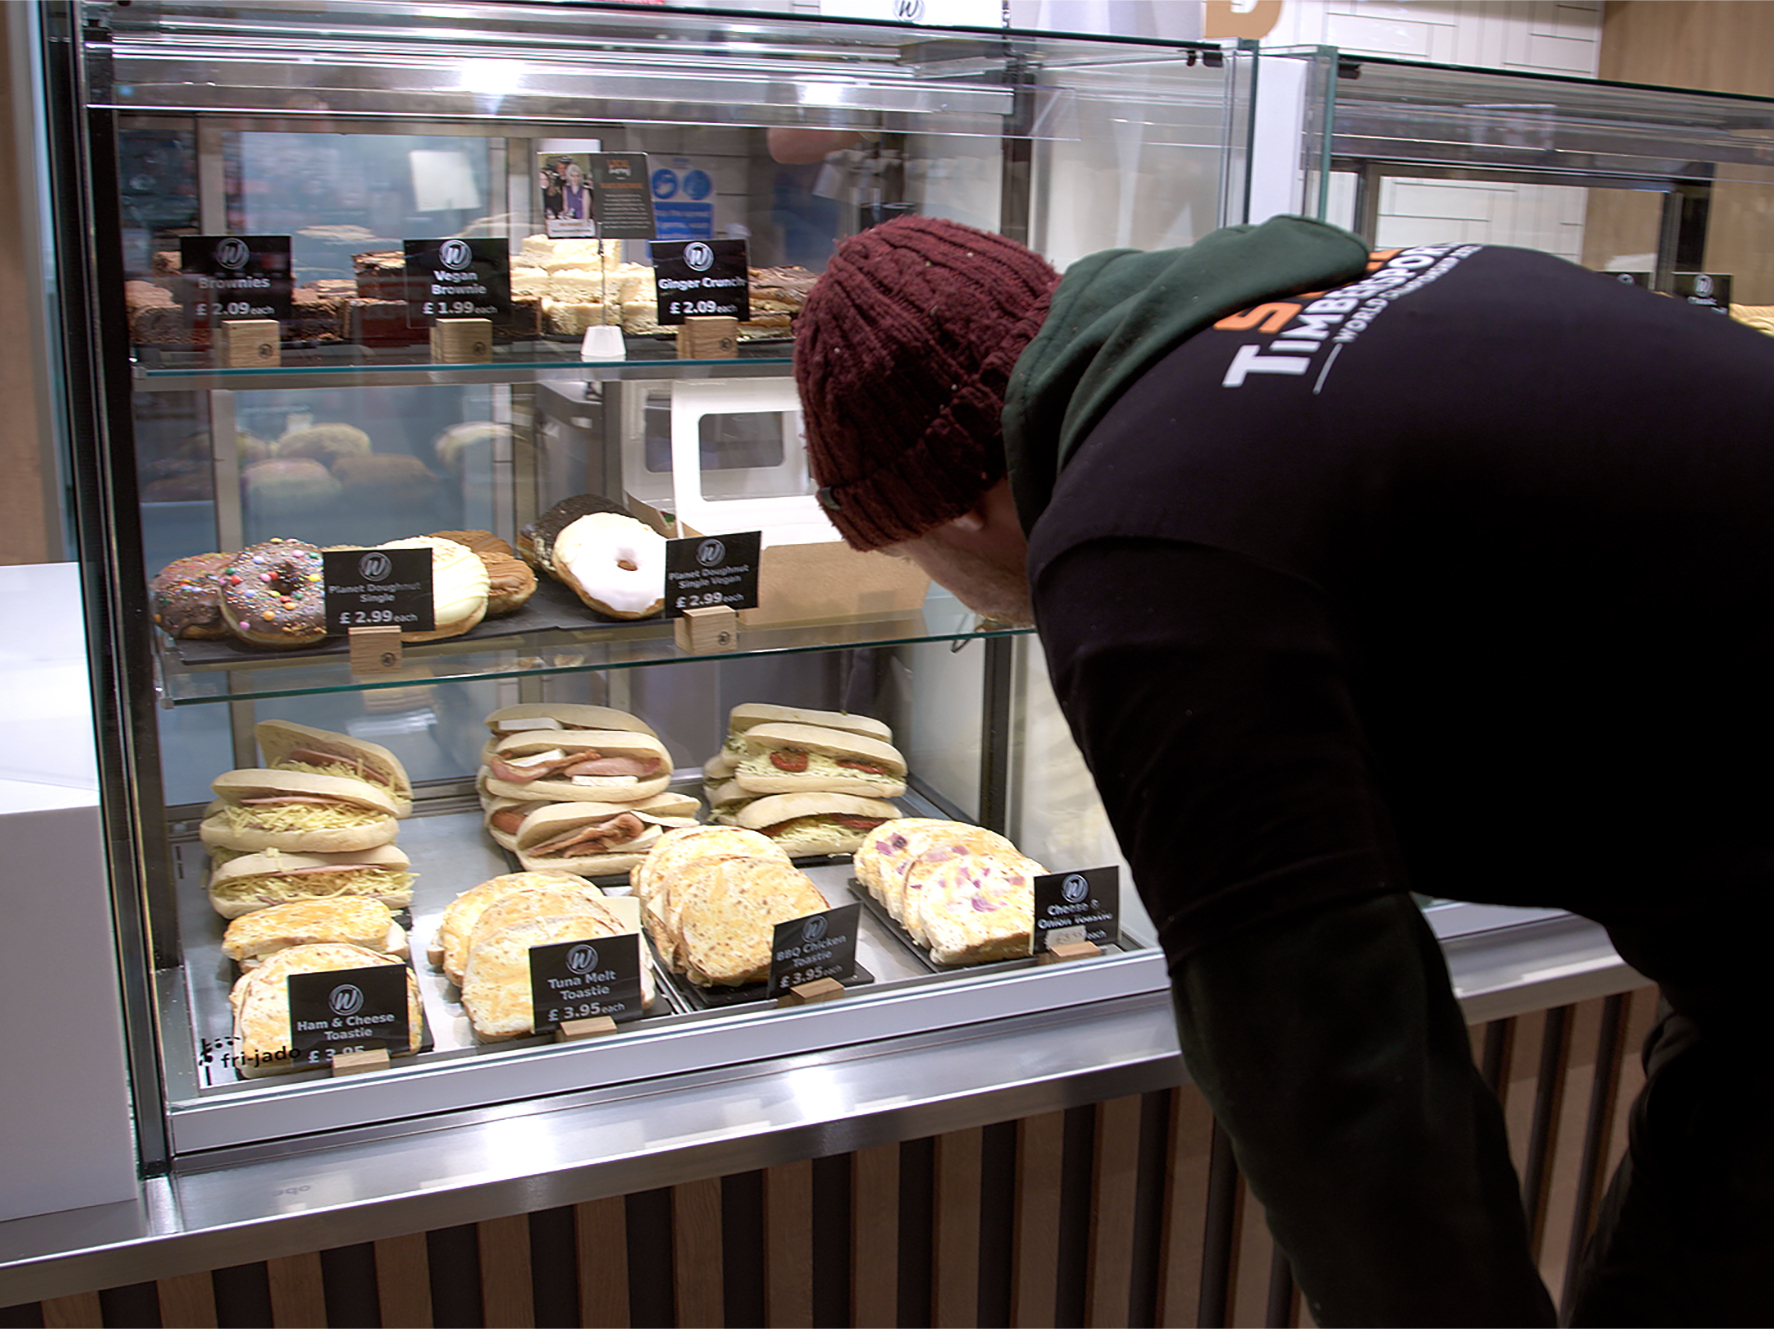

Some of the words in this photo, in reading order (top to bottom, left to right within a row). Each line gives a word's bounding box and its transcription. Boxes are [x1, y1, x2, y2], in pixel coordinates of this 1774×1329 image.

[199, 276, 271, 289] Brownies
[433, 270, 478, 283] Vegan
[658, 278, 700, 291] Ginger
[702, 276, 746, 288] Crunch
[431, 284, 487, 295] Brownie
[196, 304, 208, 316] £
[212, 302, 250, 315] 2.09
[250, 305, 276, 315] each
[422, 302, 435, 314] £
[438, 301, 475, 314] 1.99
[669, 302, 681, 314] £
[683, 301, 717, 313] 2.09
[1332, 297, 1389, 343] WORLD
[360, 593, 395, 603] Single
[675, 597, 686, 608] £
[689, 591, 723, 606] 2.99
[339, 612, 351, 624] £
[354, 610, 393, 623] 2.99
[393, 613, 419, 622] each
[547, 977, 582, 989] Tuna
[584, 970, 617, 984] Melt
[791, 965, 824, 985] 3.95
[559, 985, 611, 1000] Toastie
[547, 1008, 560, 1022] £
[562, 1002, 601, 1019] 3.95
[601, 1002, 626, 1014] each
[296, 1020, 329, 1031] Ham
[331, 1017, 343, 1028] &
[345, 1013, 395, 1026] Cheese
[323, 1027, 374, 1041] Toastie
[221, 1045, 301, 1069] fri-jado
[307, 1050, 320, 1064] £
